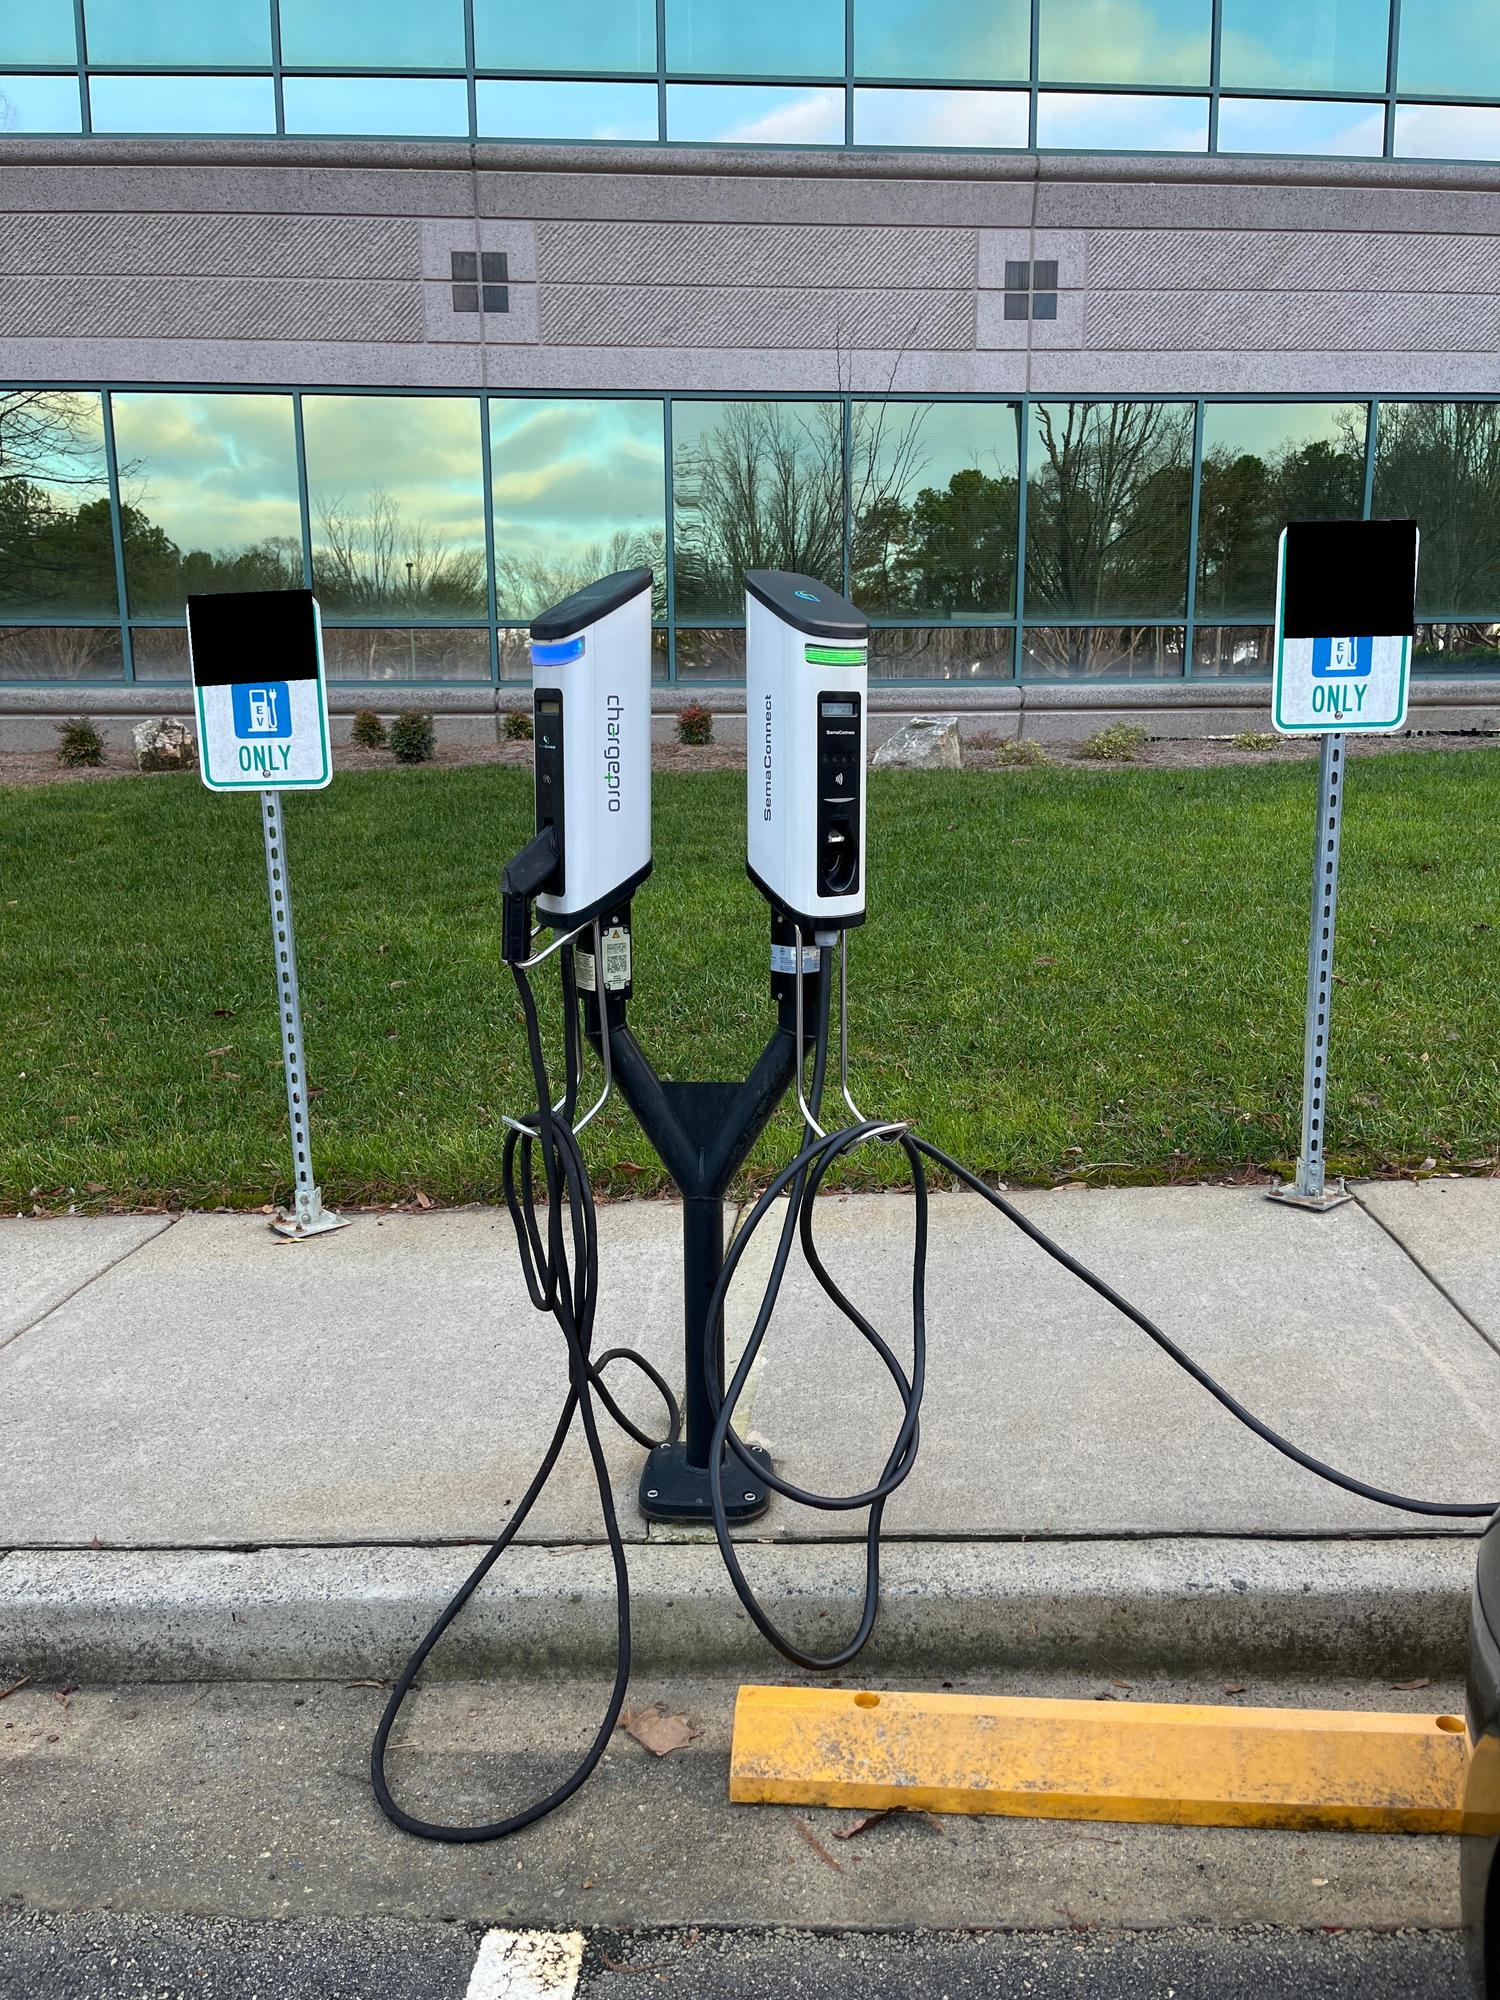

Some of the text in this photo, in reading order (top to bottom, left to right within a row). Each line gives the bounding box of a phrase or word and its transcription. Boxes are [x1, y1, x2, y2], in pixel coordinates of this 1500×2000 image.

[1335, 641, 1345, 665] EV
[1312, 683, 1368, 712] ONLY
[256, 705, 265, 727] EV
[238, 744, 291, 771] ONLY
[763, 694, 772, 822] SemaConnect
